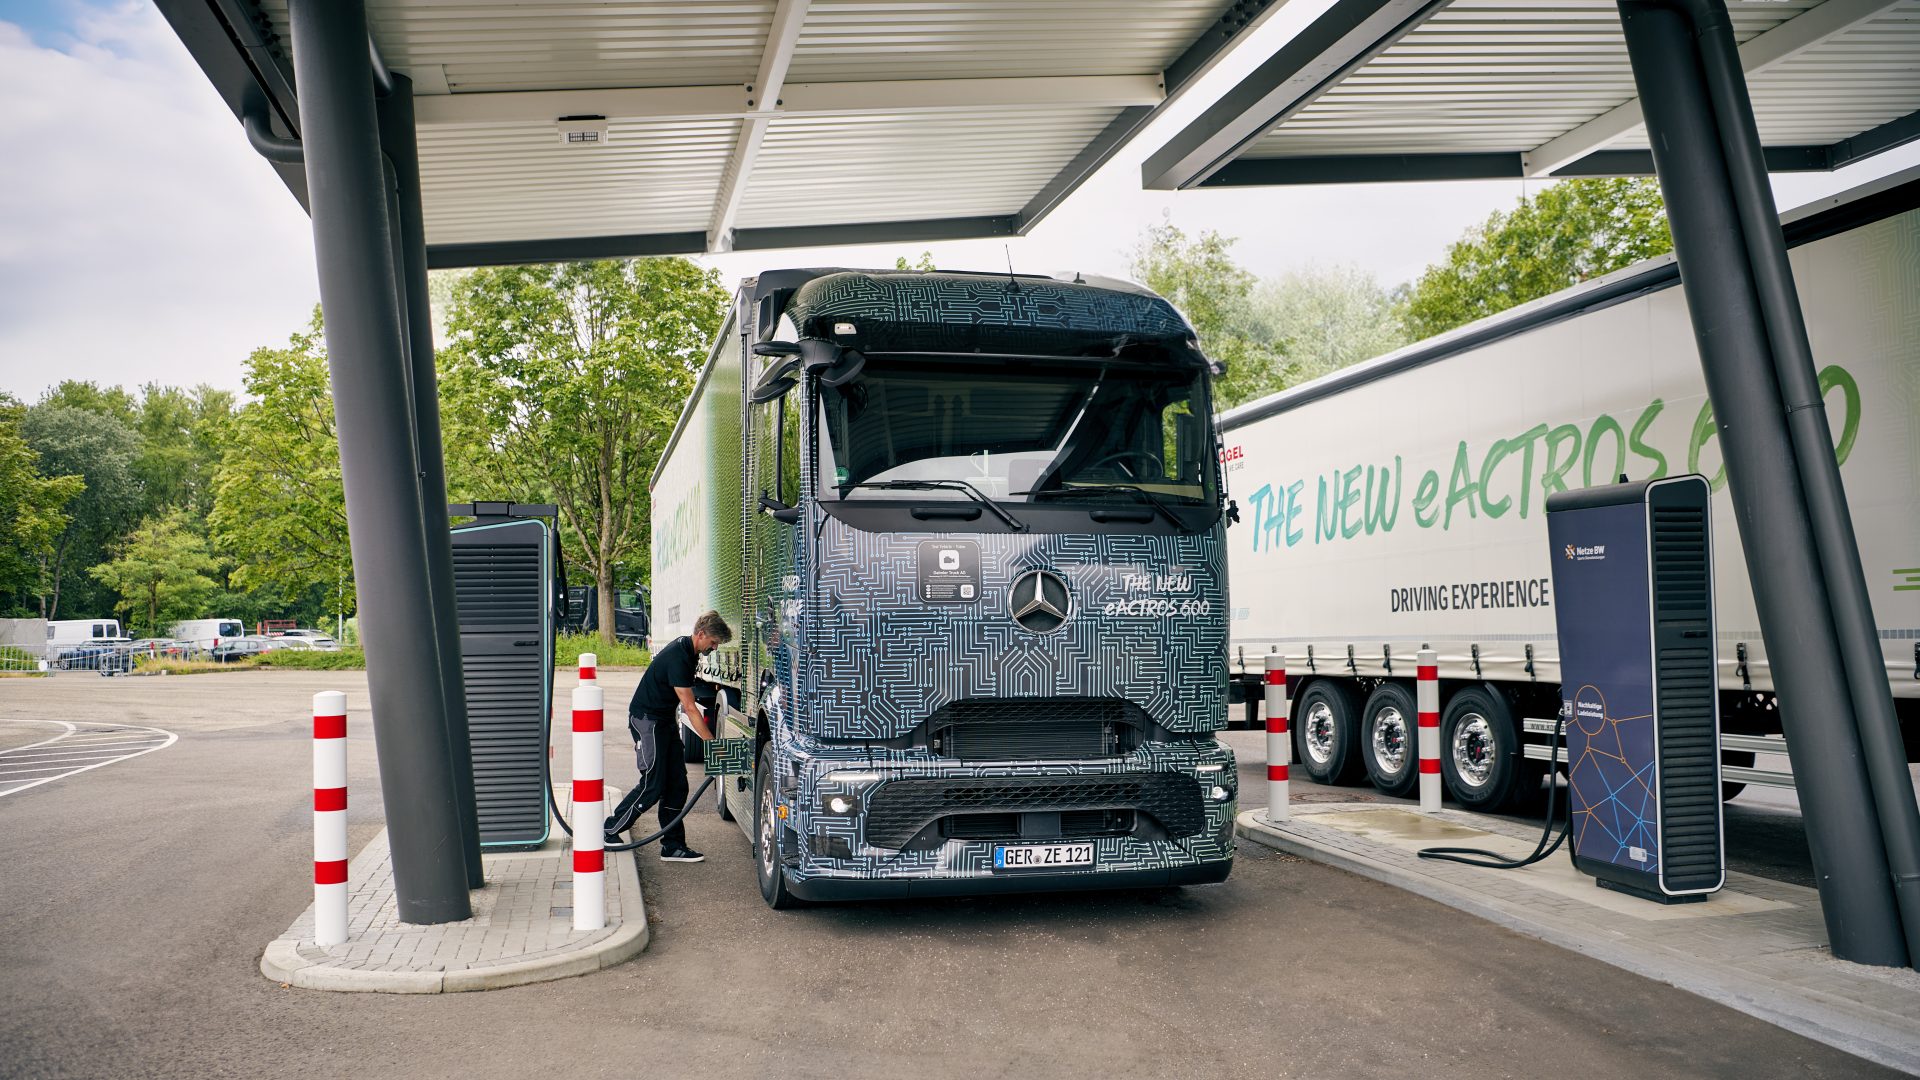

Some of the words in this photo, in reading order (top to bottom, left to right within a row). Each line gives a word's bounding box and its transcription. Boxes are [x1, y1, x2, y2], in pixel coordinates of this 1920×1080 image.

[1219, 446, 1243, 463] OGEL
[1248, 479, 1304, 554] THE
[1315, 454, 1402, 545] NEW
[1412, 398, 1668, 531] eACTROS
[1688, 365, 1861, 495] 60
[1576, 547, 1593, 555] Netze
[1593, 545, 1604, 555] BW
[1122, 574, 1151, 592] THE
[1156, 574, 1192, 592] NEW
[1391, 585, 1449, 613] DRIVING
[1452, 578, 1550, 610] EXPERIENCE
[1104, 598, 1178, 618] eACTROS
[1180, 599, 1210, 616] 600
[1005, 849, 1033, 865] GER
[1044, 847, 1062, 864] ZE
[1065, 846, 1091, 863] 121
